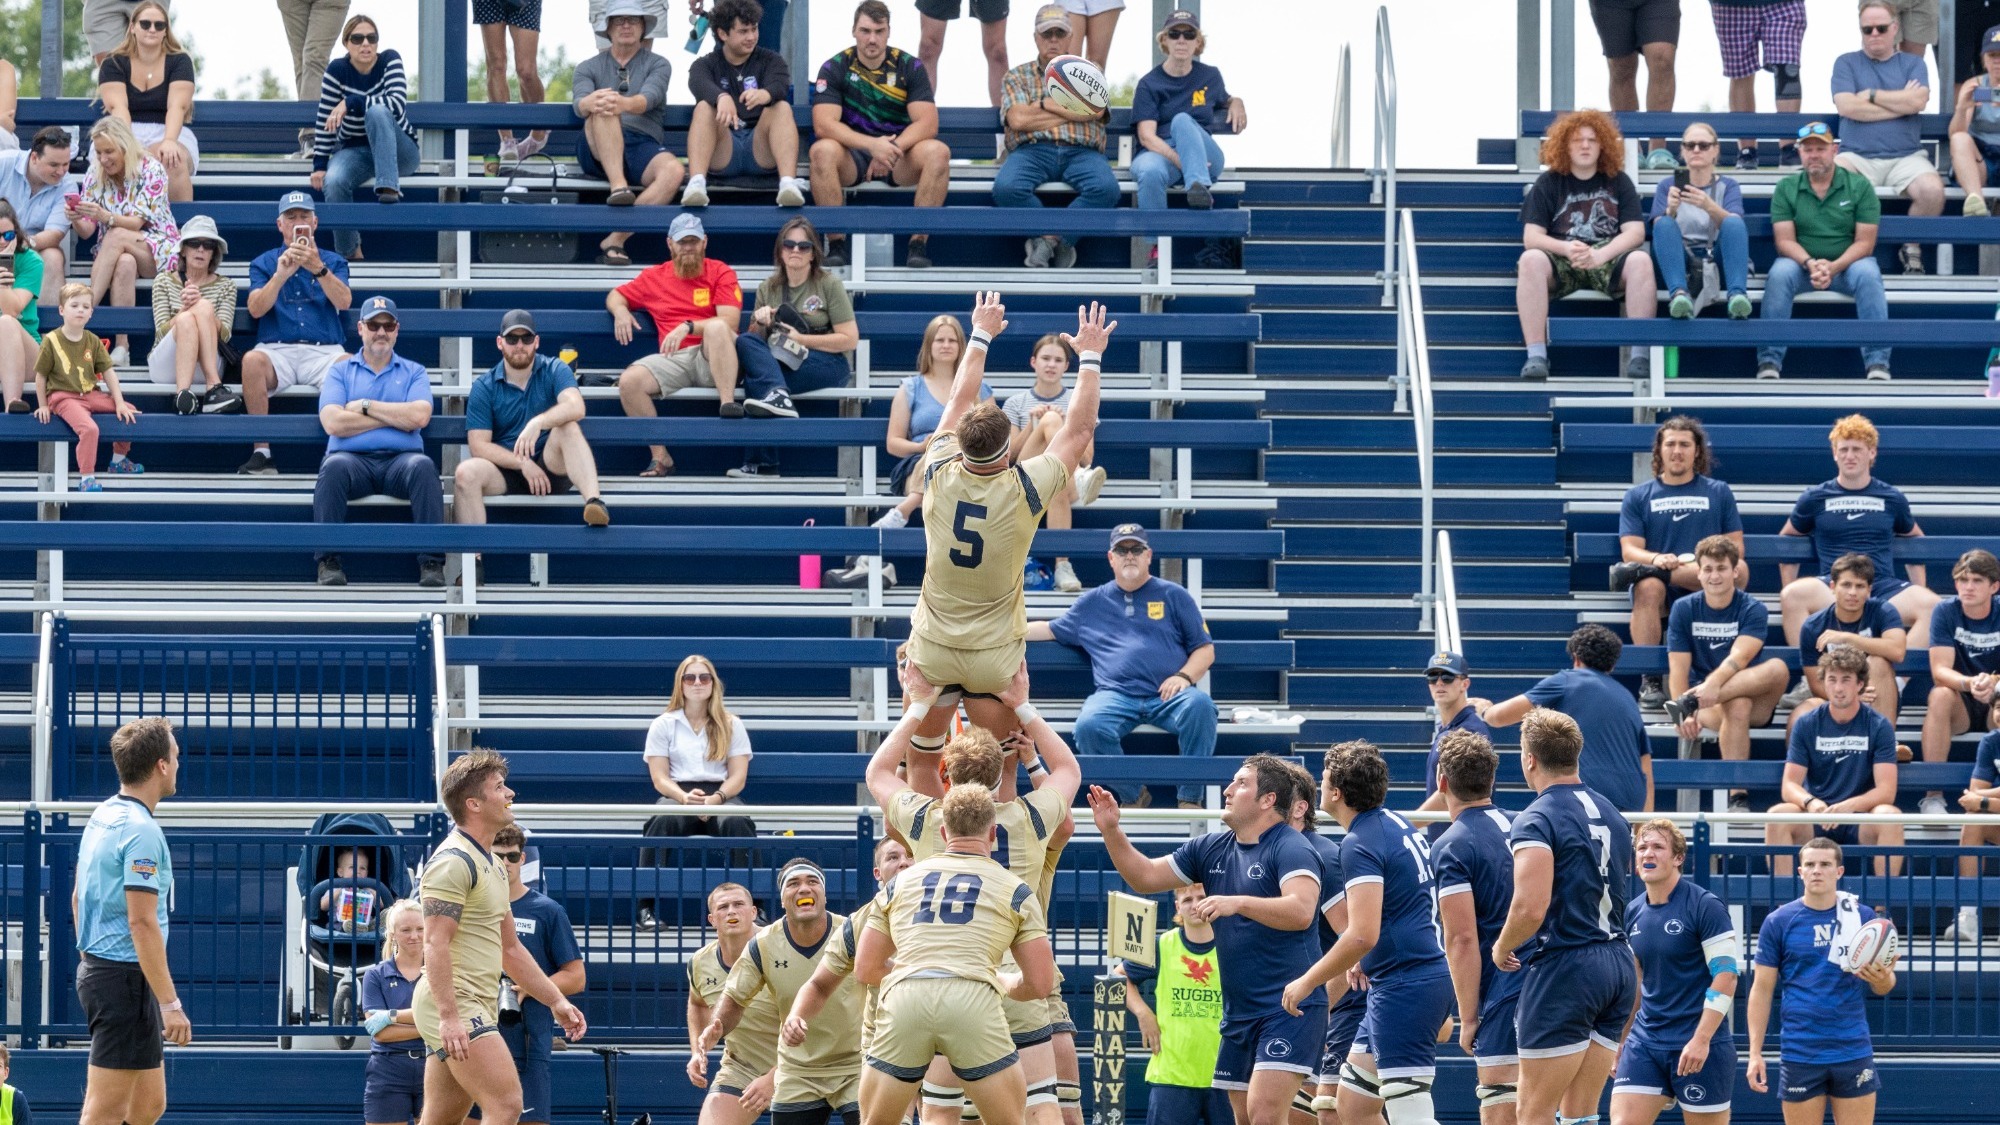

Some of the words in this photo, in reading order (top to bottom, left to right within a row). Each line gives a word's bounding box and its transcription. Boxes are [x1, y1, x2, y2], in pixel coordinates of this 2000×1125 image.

[949, 500, 988, 569] 5
[1588, 824, 1611, 877] 7
[912, 872, 983, 924] 18
[1126, 912, 1144, 944] N
[1813, 924, 1831, 941] N
[1125, 942, 1144, 955] NAVY
[1171, 1001, 1223, 1019] EAST
[1172, 987, 1223, 1003] RUGBY
[470, 1015, 483, 1028] N
[1093, 1008, 1106, 1103] NAVY
[1106, 1010, 1126, 1104] NAVY
